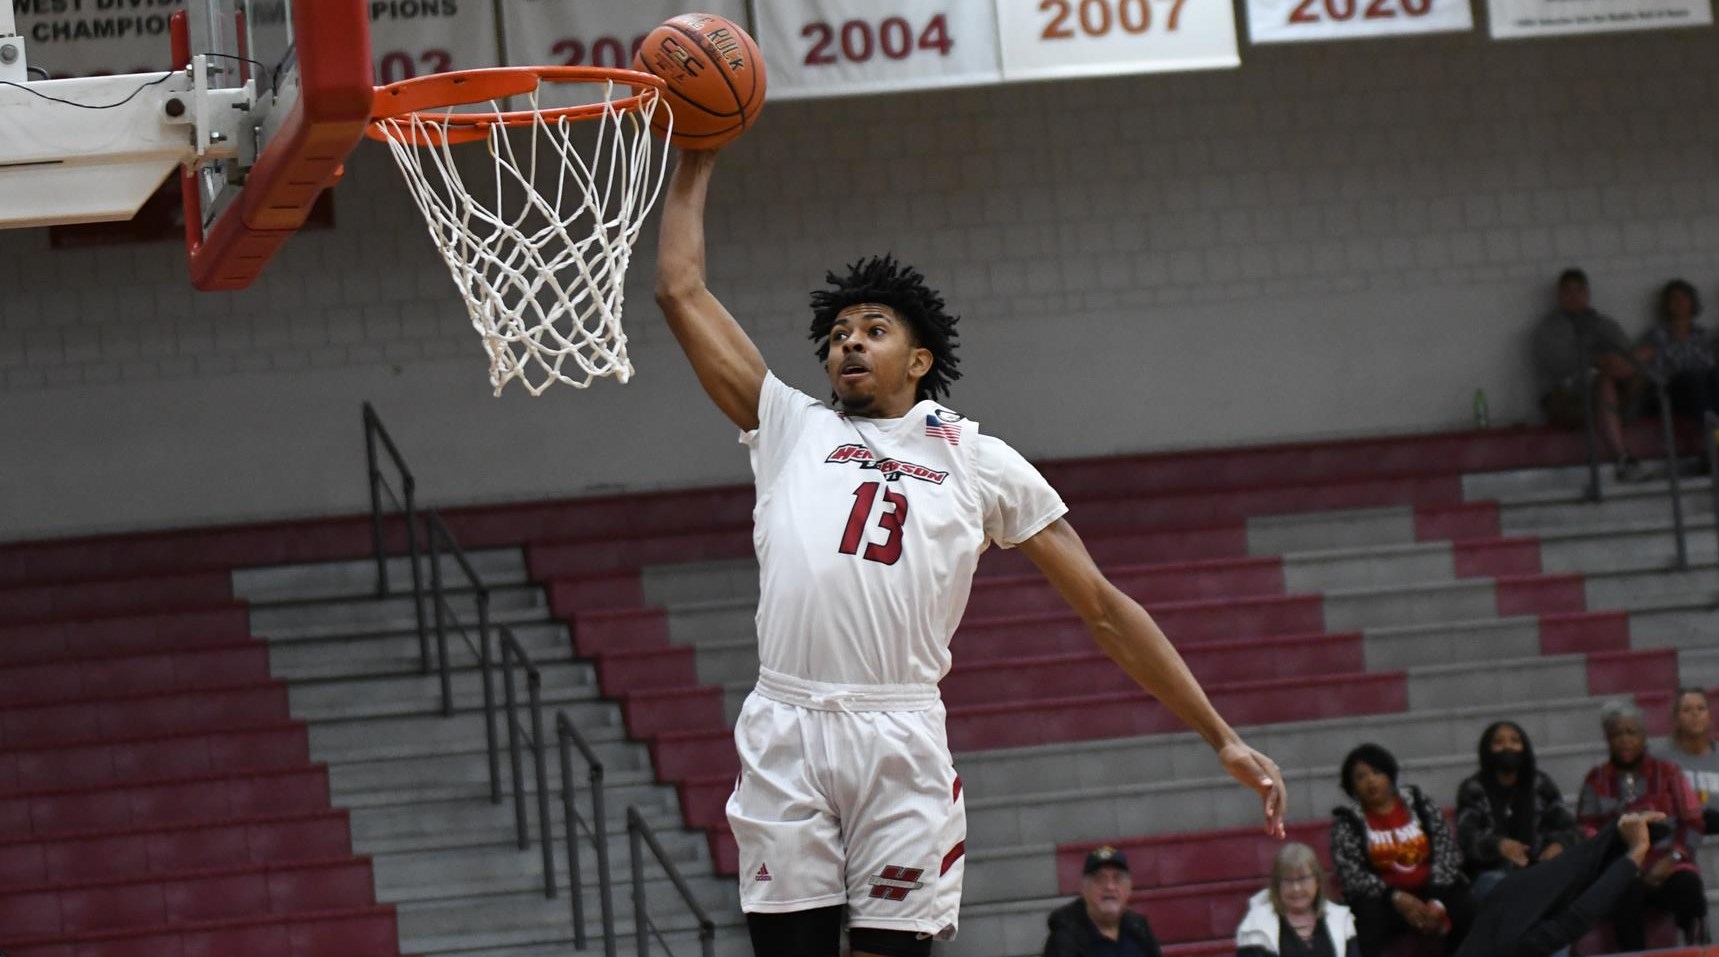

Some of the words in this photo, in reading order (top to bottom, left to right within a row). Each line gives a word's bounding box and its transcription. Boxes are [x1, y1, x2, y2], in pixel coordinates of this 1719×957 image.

[32, 14, 172, 42] CHAMPIO
[801, 13, 955, 66] 2004
[1039, 0, 1186, 40] 2007
[838, 481, 909, 566] 13
